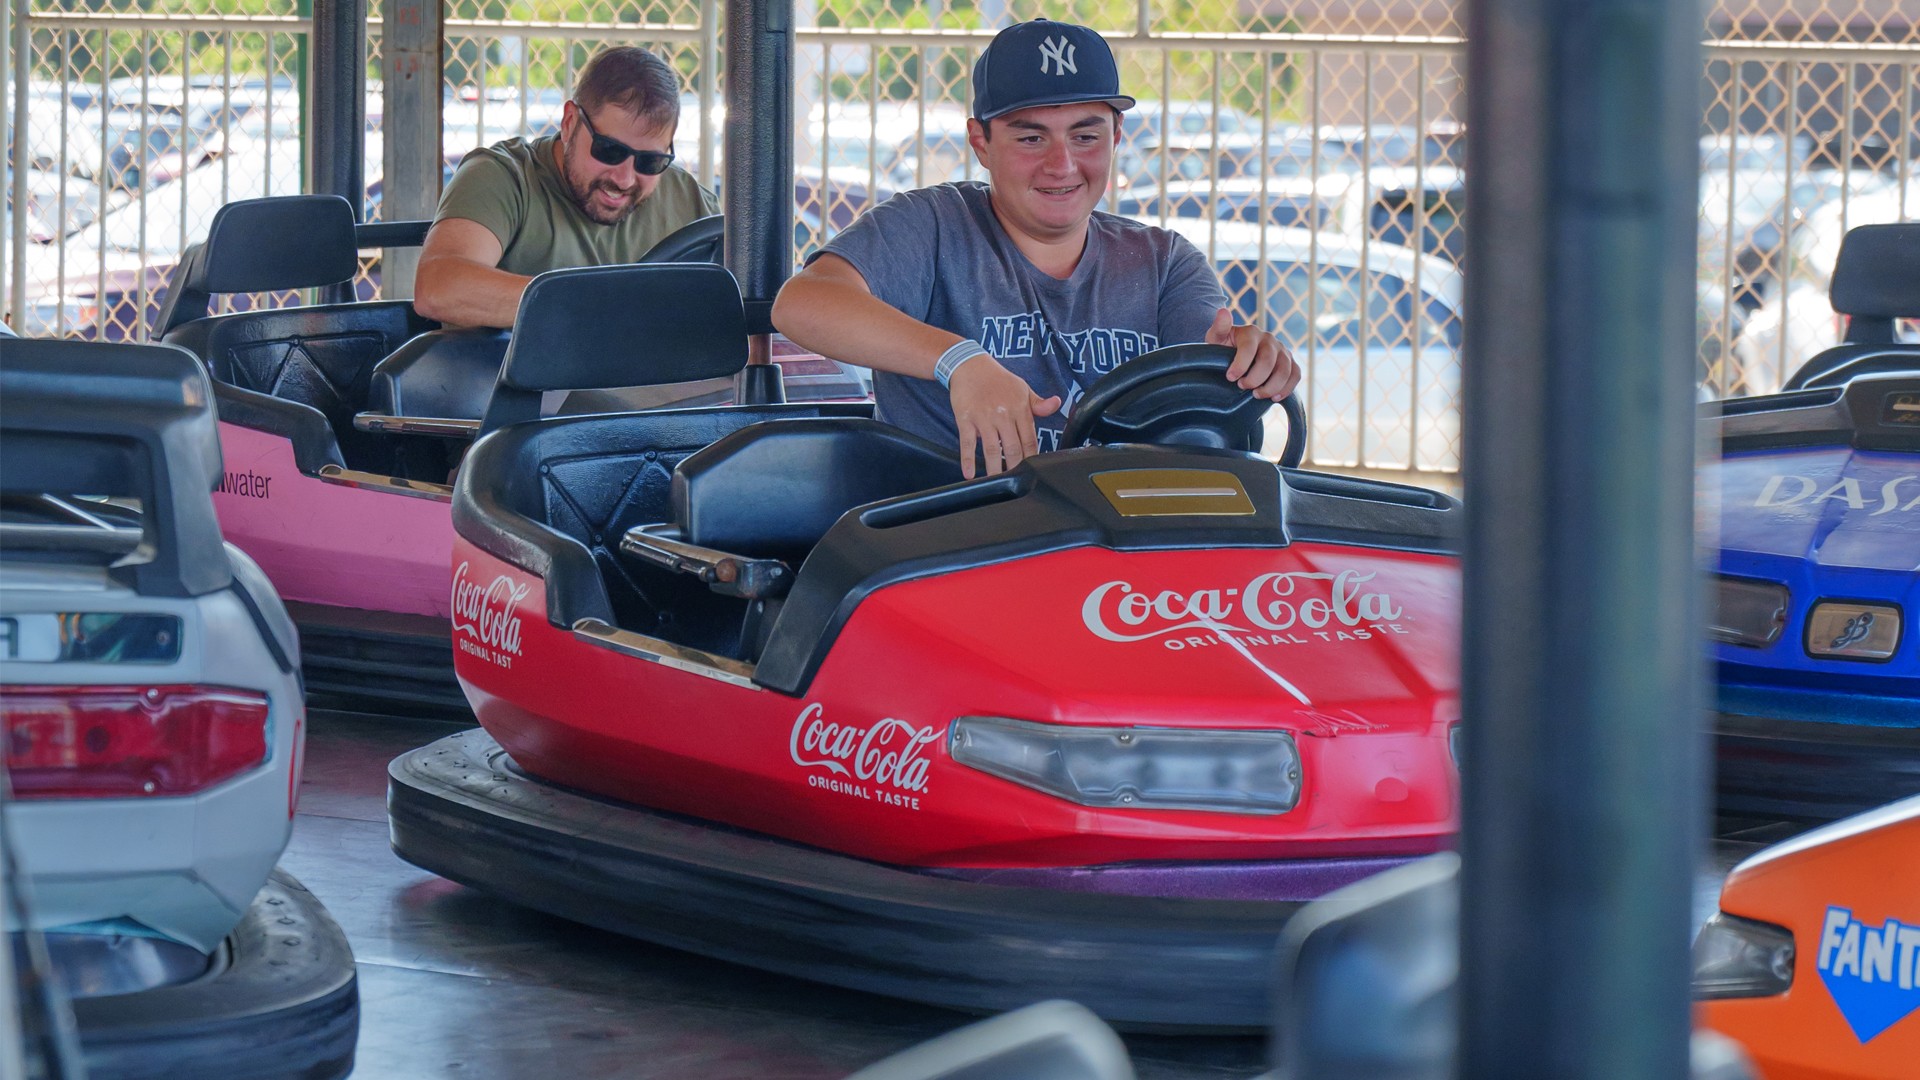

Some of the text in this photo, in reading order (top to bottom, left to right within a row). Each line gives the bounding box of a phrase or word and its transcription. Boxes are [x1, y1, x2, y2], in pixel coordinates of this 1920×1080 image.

[1038, 35, 1078, 76] NY
[1082, 569, 1404, 643] Coca-Cola
[1313, 623, 1410, 642] TASTE
[459, 638, 512, 670] ORIGINAL TAST
[808, 774, 920, 811] ORIGINAL TASTE
